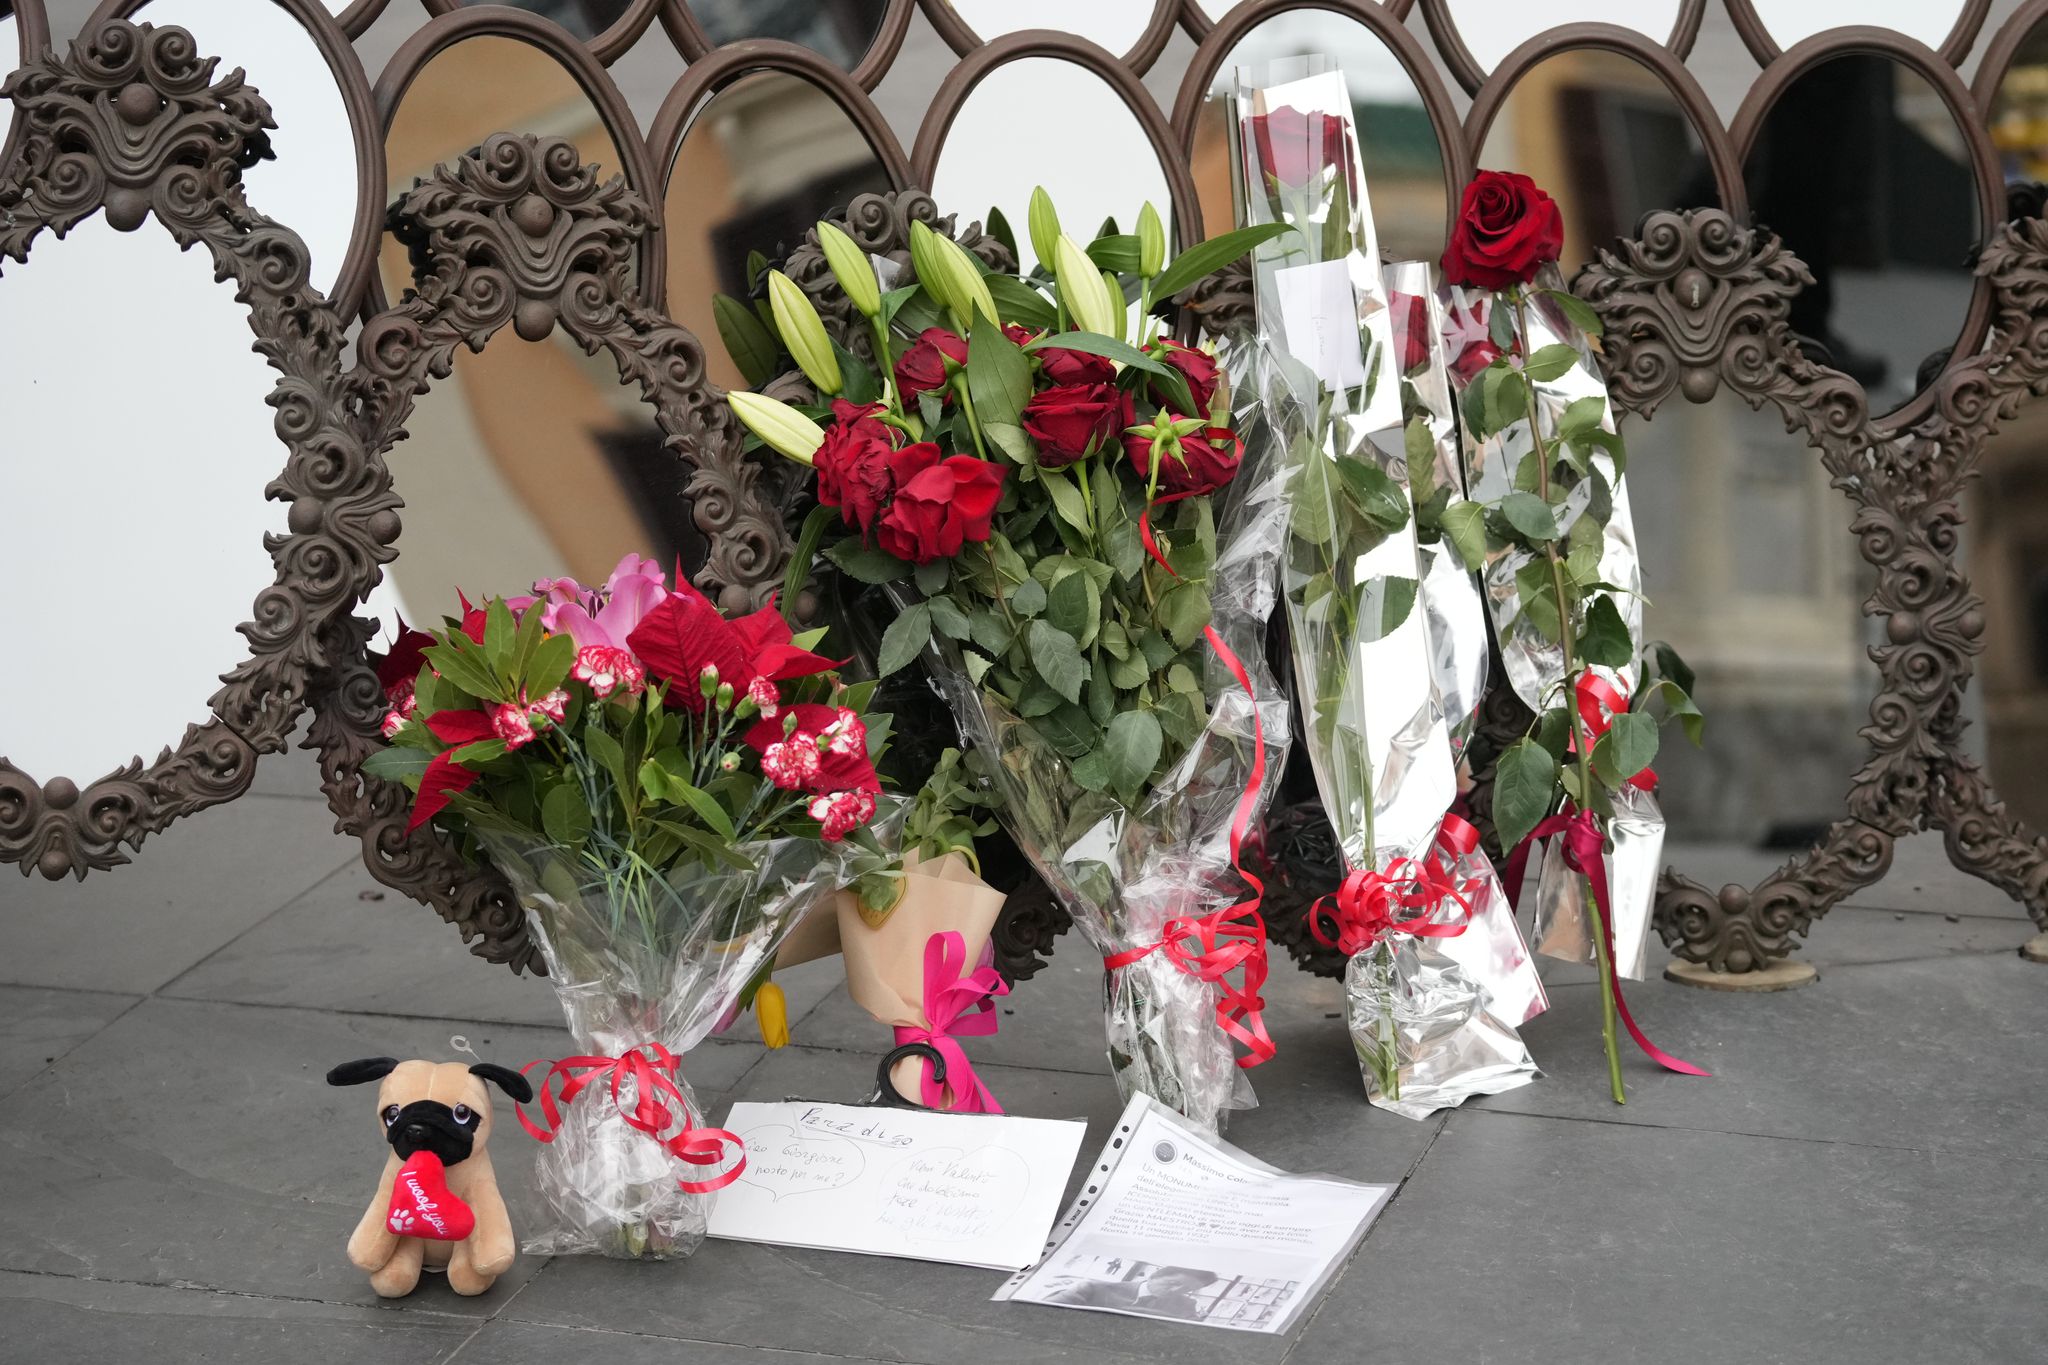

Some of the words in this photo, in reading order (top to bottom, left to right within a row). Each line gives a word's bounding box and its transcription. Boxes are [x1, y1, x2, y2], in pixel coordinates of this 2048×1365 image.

[755, 1164, 787, 1176] posto
[1142, 1162, 1155, 1174] Un
[1182, 1153, 1224, 1177] Massimo
[406, 1178, 438, 1212] woof
[421, 1212, 449, 1235] you
